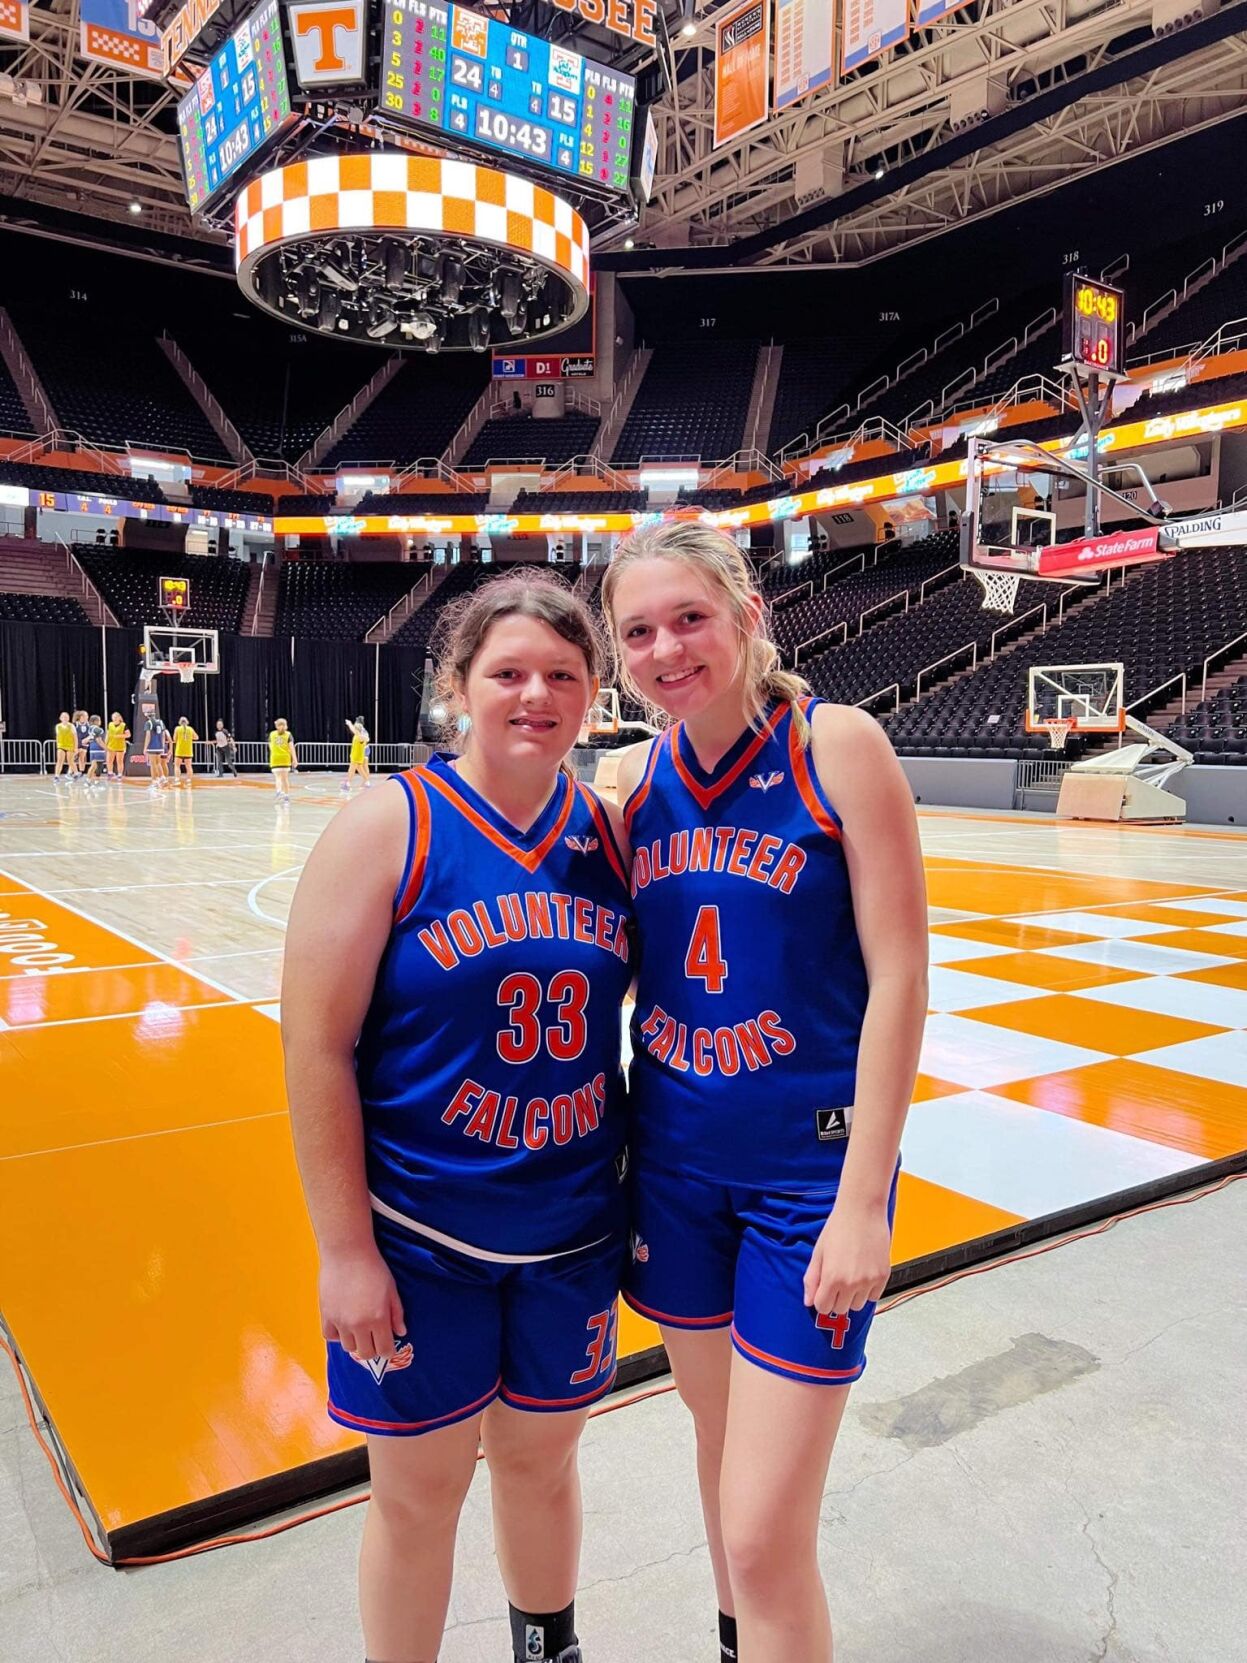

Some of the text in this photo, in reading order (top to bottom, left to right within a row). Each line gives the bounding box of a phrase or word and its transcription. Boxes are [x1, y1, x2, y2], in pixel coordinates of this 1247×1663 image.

[393, 10, 403, 25] 0
[553, 0, 657, 48] SEE
[296, 7, 358, 72] T
[392, 31, 402, 46] 3
[391, 52, 401, 67] 5
[512, 52, 523, 70] 1
[386, 71, 404, 89] 25
[453, 59, 482, 88] 24
[242, 70, 256, 103] 15
[490, 84, 499, 98] 4
[385, 91, 403, 110] 30
[530, 99, 538, 112] 4
[550, 96, 575, 123] 15
[586, 105, 593, 118] 1
[455, 113, 465, 130] 4
[479, 109, 547, 154] 10:43
[584, 123, 592, 138] 4
[219, 123, 249, 172] 10:43
[560, 151, 570, 166] 4
[1203, 200, 1224, 216] 319
[1062, 251, 1079, 264] 318
[1078, 286, 1117, 323] 10:43
[700, 318, 716, 328] 317
[879, 311, 901, 322] 317A
[536, 386, 554, 397] 316
[39, 493, 55, 508] 15
[684, 905, 728, 994] 4
[496, 969, 590, 1065] 33
[641, 1005, 797, 1076] FALCONS
